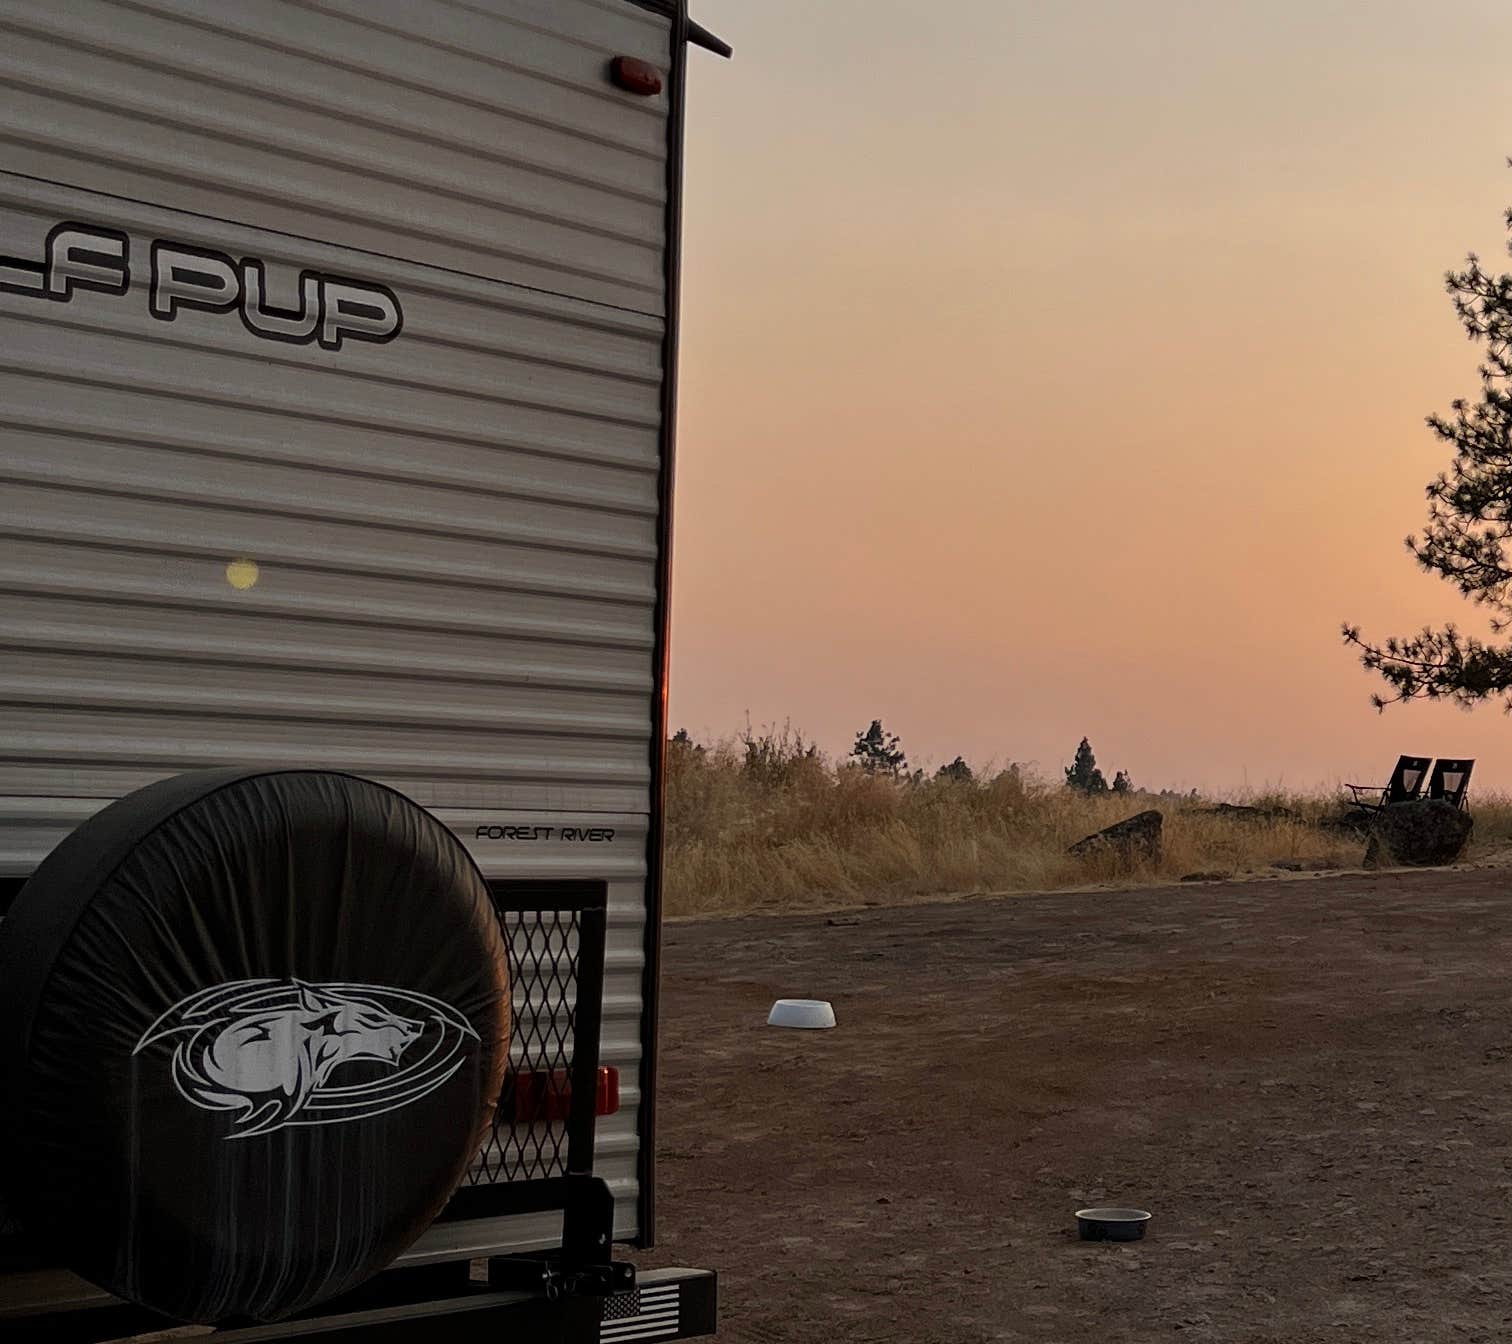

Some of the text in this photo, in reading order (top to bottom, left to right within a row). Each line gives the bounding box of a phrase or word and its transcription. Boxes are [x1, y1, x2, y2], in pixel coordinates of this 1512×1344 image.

[149, 239, 403, 351] PUP
[475, 826, 615, 842] FOREST RIVER
